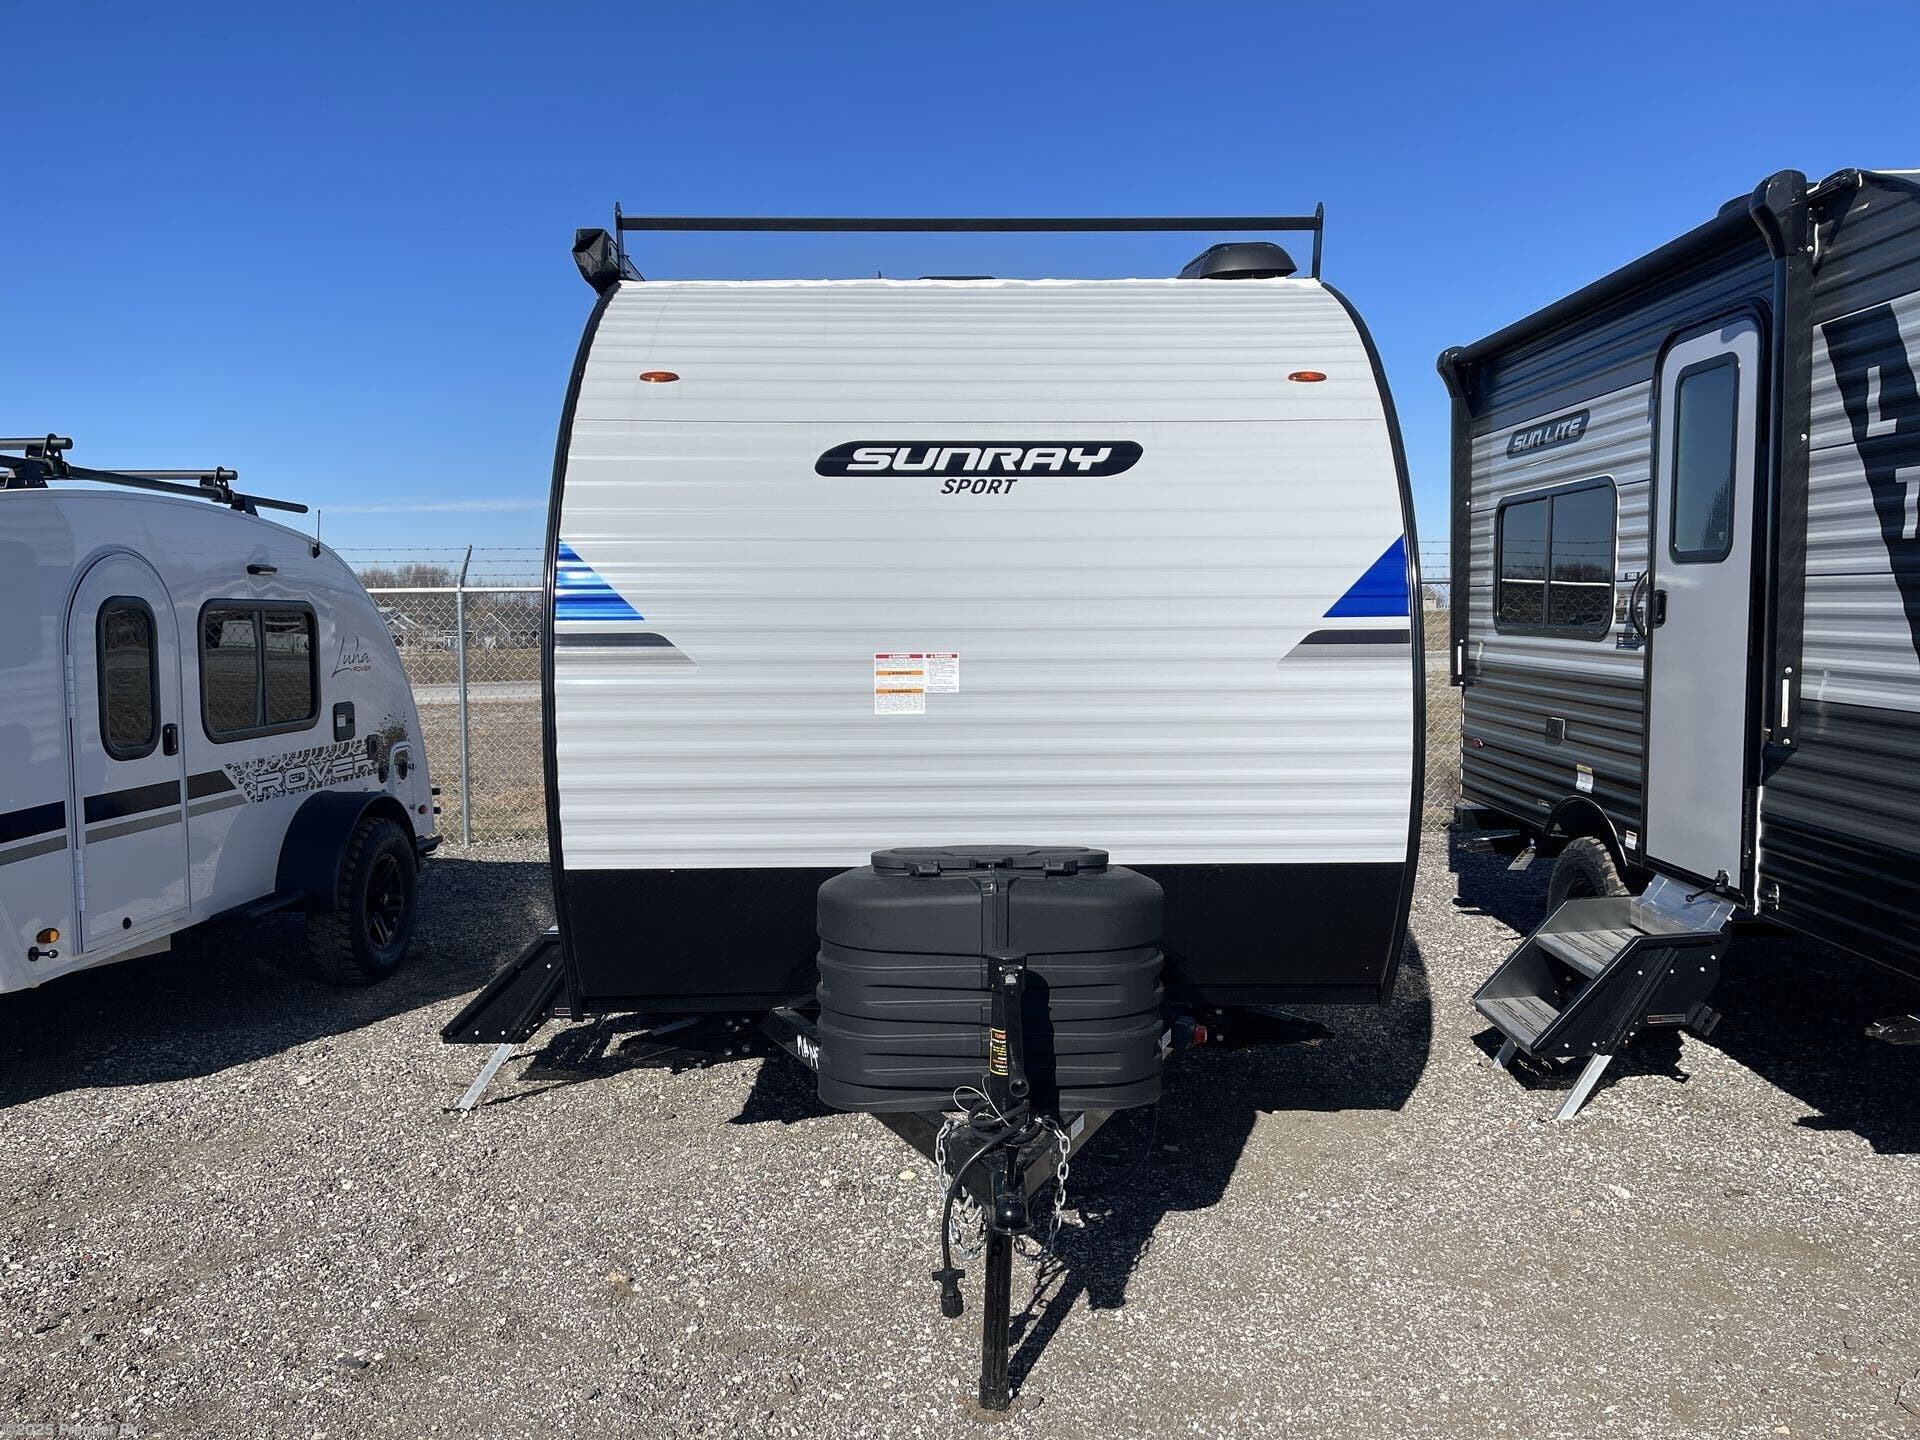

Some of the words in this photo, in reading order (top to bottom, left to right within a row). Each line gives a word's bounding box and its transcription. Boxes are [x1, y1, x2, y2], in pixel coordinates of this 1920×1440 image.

[1512, 429, 1542, 453] SUN
[1544, 417, 1582, 445] LITE
[846, 447, 1112, 471] SUNRAY
[940, 478, 1017, 495] SPORT
[331, 634, 370, 678] Luna
[255, 753, 375, 798] ROVER
